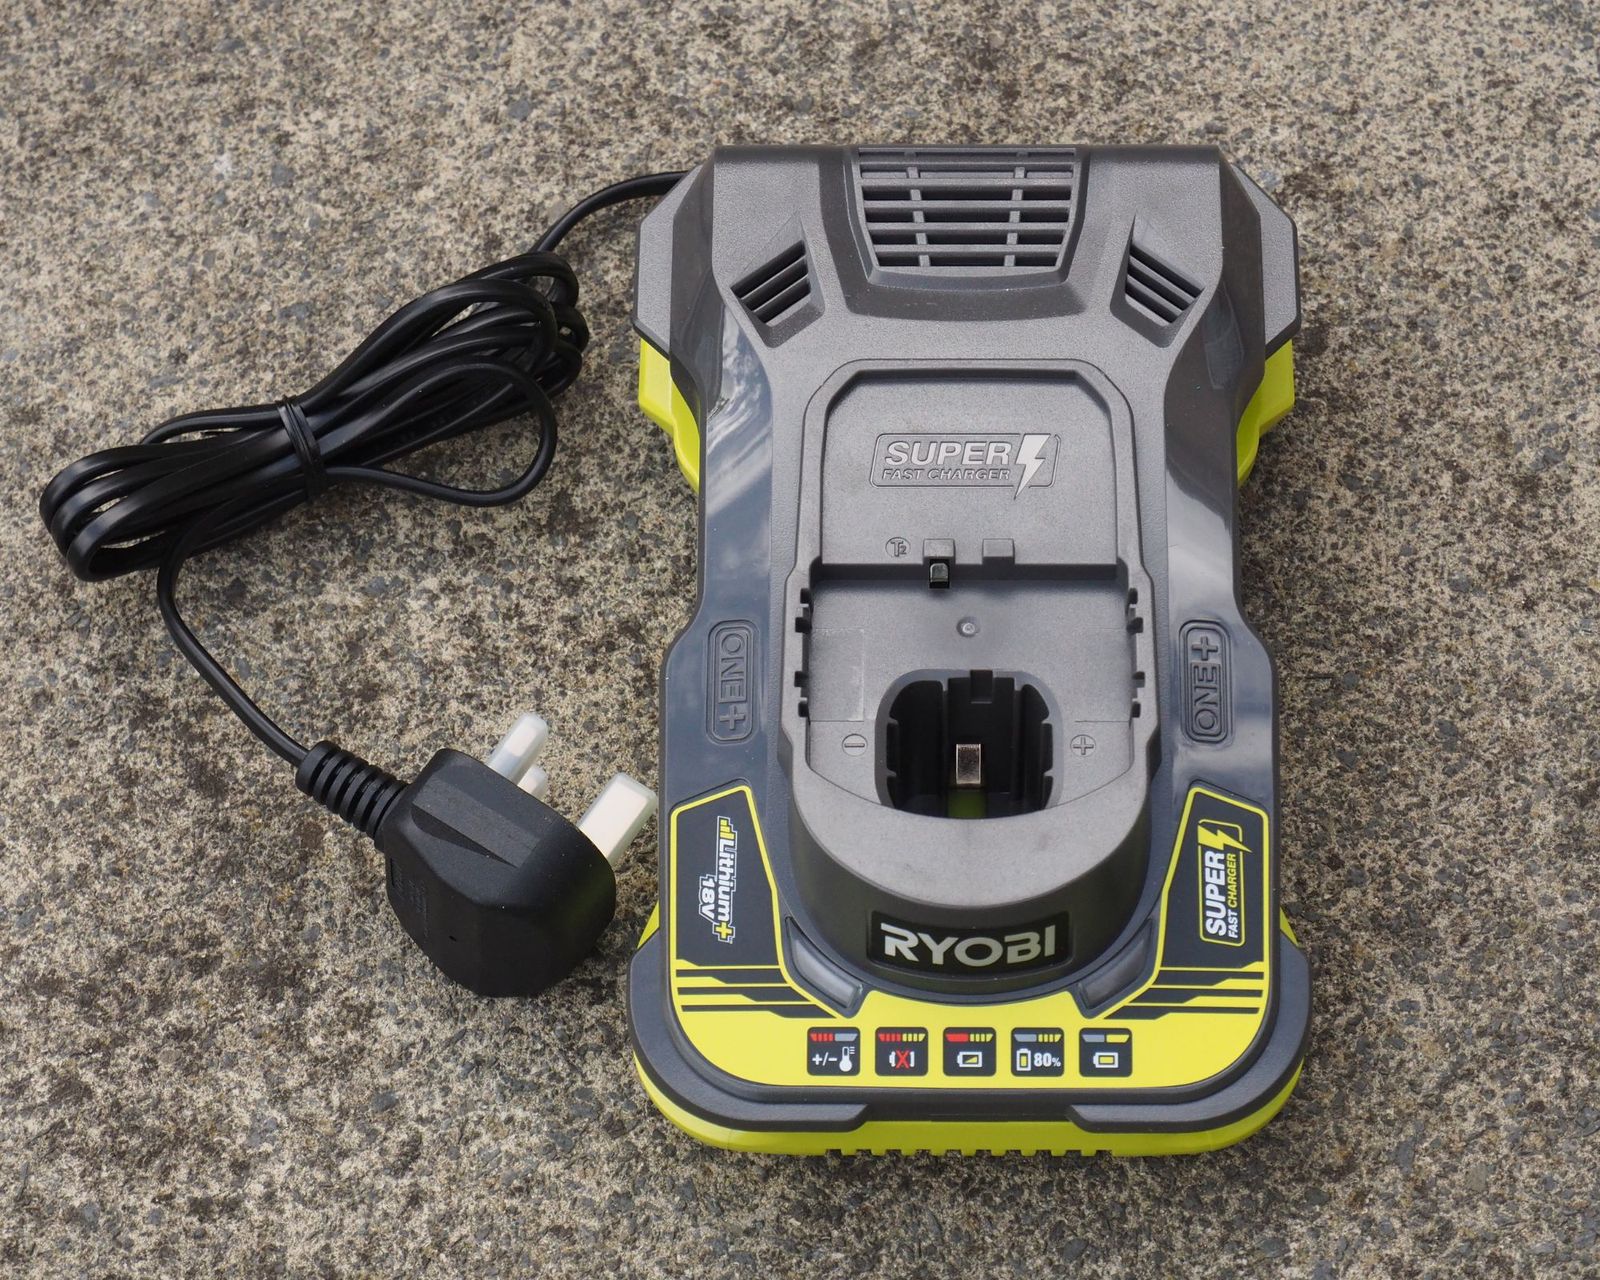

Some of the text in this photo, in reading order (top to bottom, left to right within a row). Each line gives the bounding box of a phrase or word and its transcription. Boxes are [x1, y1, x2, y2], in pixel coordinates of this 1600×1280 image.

[881, 468, 1012, 481] FAST CHARGER
[884, 440, 1013, 466] SUPER
[719, 632, 748, 731] ONE+
[1190, 635, 1221, 731] ONE+
[701, 877, 716, 920] 18V
[716, 838, 735, 940] Lithium+
[1204, 850, 1227, 937] SUPER
[1226, 852, 1239, 939] FAST CHARGER
[880, 922, 1056, 968] RYOBI
[1033, 1052, 1062, 1068] 80%
